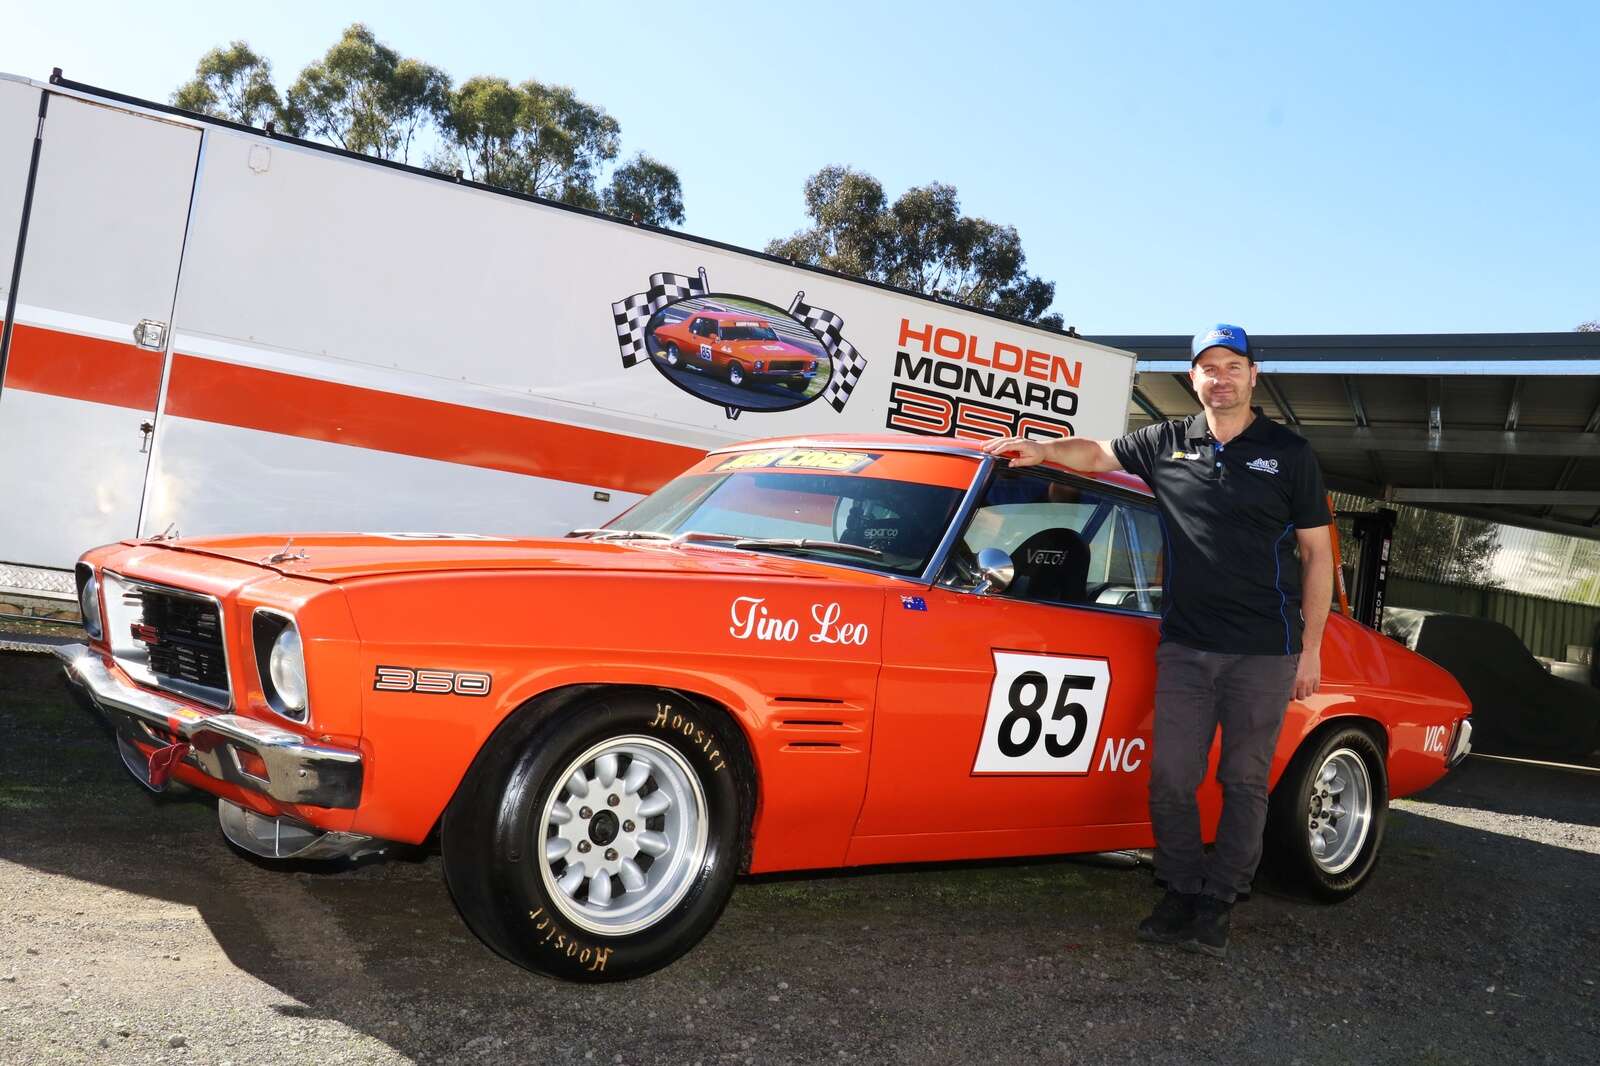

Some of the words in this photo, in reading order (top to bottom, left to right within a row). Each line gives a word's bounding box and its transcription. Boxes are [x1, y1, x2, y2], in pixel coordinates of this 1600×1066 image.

[893, 350, 1079, 417] MONARO
[898, 318, 1083, 388] HOLDEN
[729, 596, 799, 641] Tino
[809, 602, 868, 645] Leo
[373, 665, 492, 697] 350
[648, 703, 726, 771] Hoosier
[997, 670, 1096, 758] 85
[1098, 737, 1146, 773] NC
[530, 907, 614, 971] Hoosier
